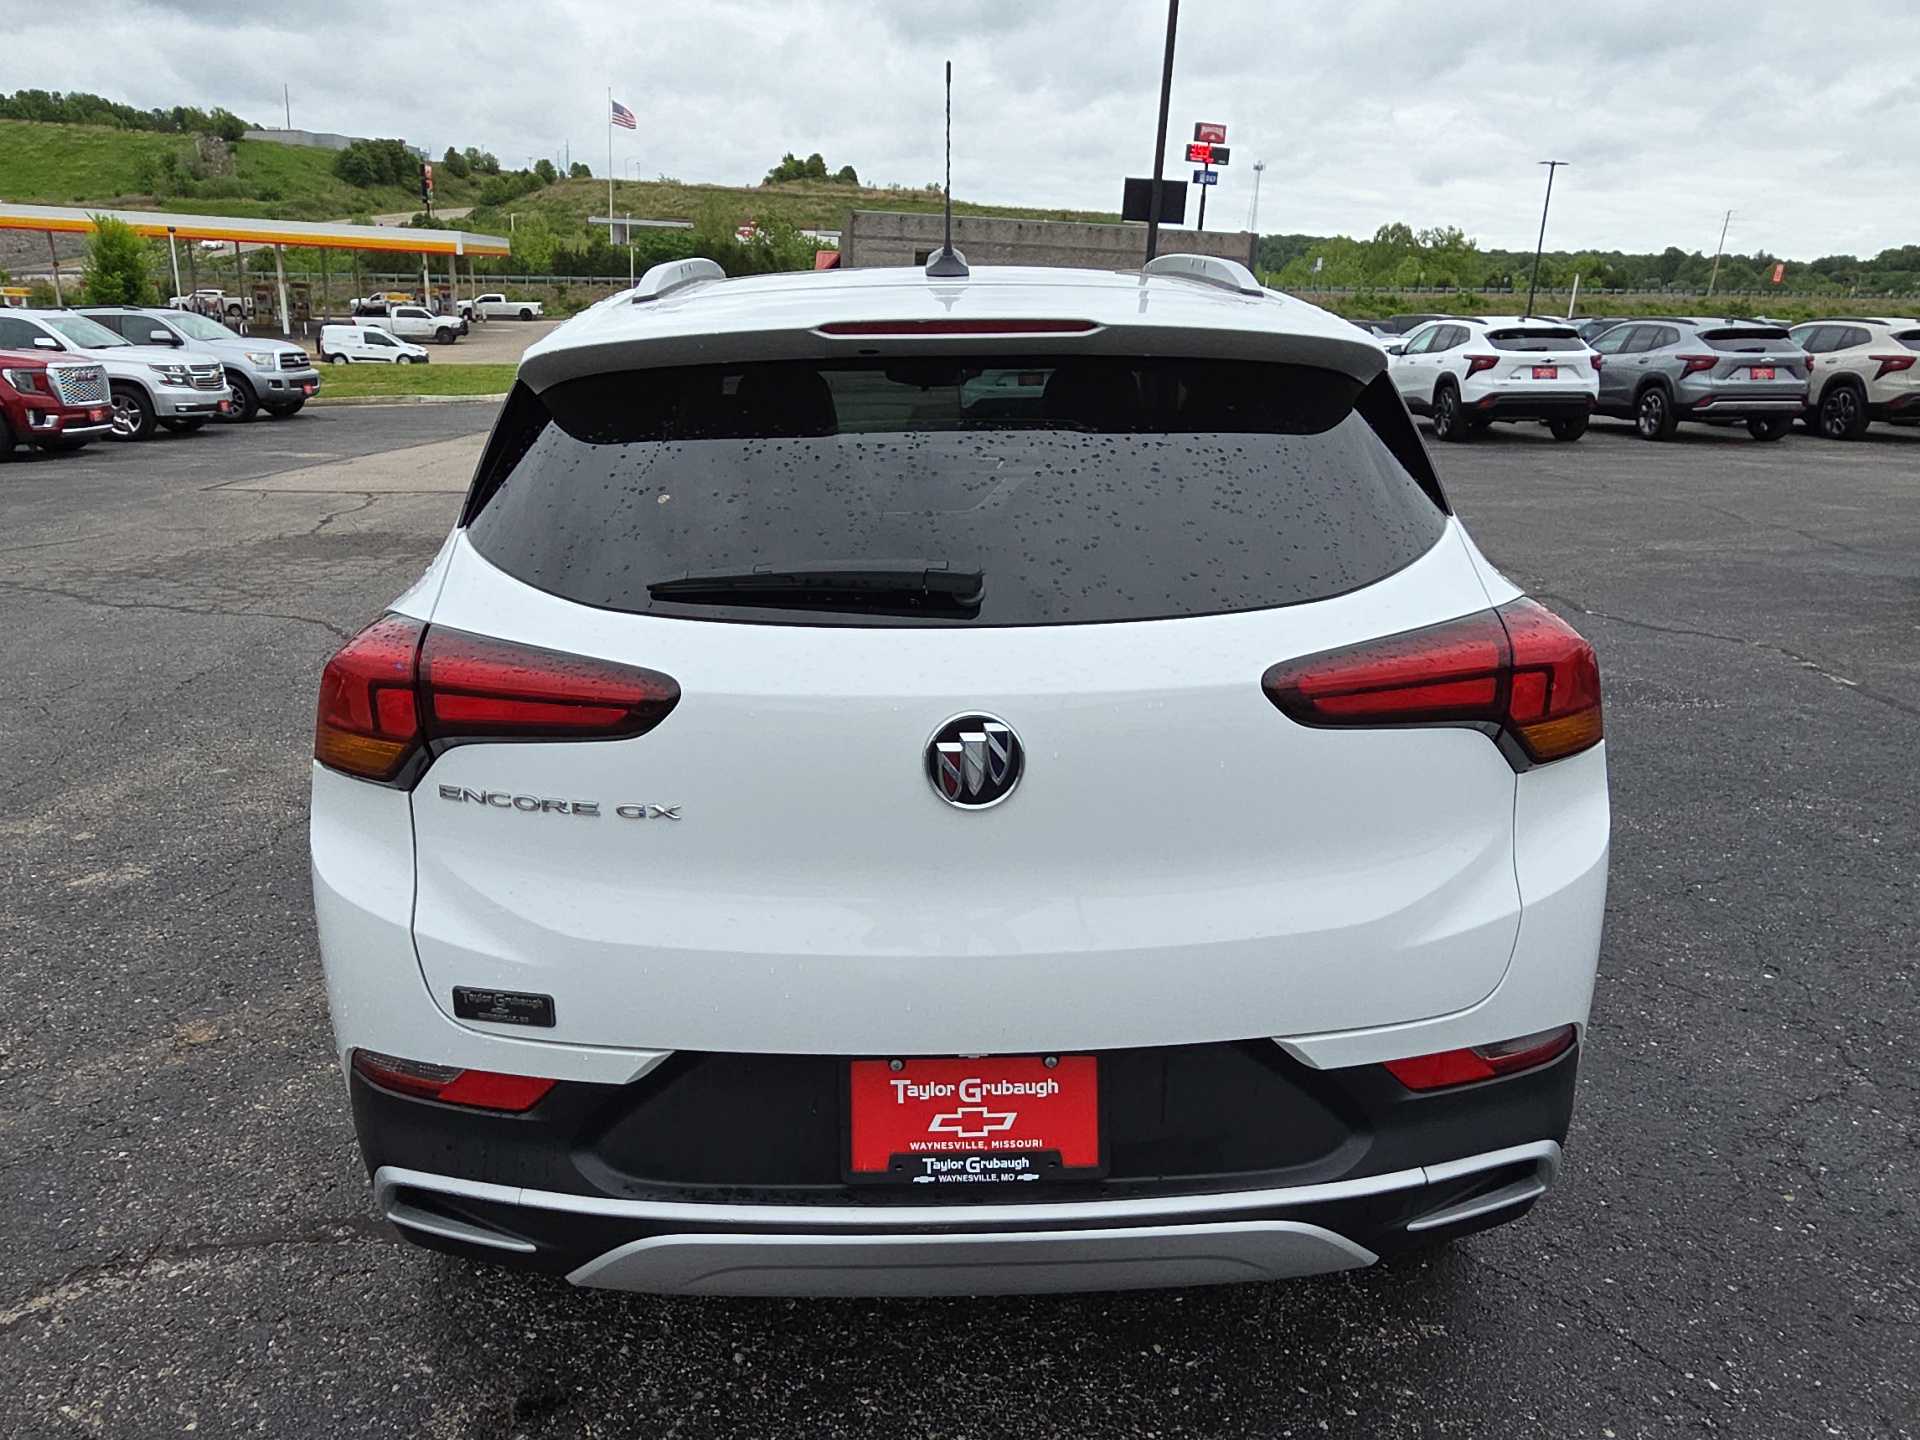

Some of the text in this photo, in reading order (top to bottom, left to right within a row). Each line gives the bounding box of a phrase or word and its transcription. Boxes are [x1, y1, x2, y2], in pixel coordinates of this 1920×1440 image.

[438, 783, 682, 820] ENCORE GX
[890, 1078, 1059, 1104] Taylor Grubaugh
[909, 1139, 1043, 1151] WAYNESVILLE, MISSOURI
[921, 1156, 1030, 1174] Taylor Grubaugh
[938, 1173, 1015, 1183] WAYNESVILLE, MO
